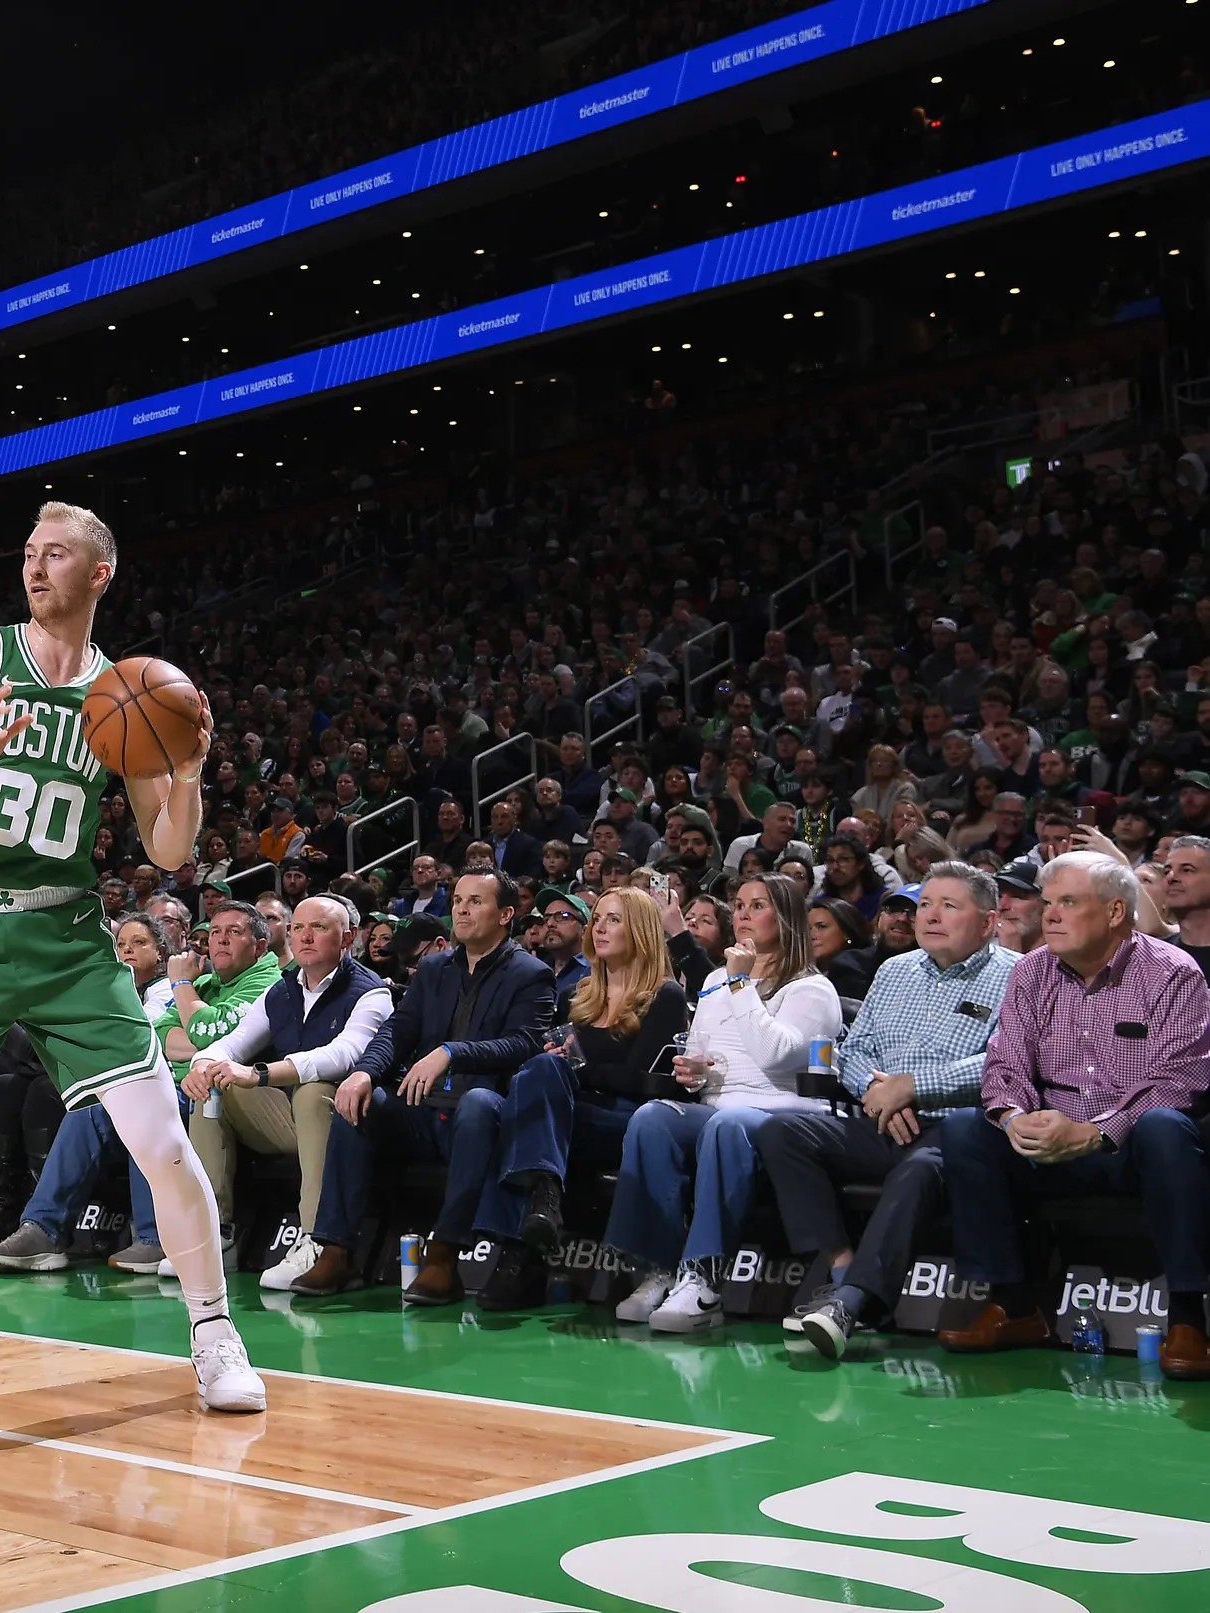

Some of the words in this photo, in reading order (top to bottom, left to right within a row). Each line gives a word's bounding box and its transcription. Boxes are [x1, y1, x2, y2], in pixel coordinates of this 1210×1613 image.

[711, 55, 732, 73] LIVE
[732, 47, 755, 66] ONLY
[755, 33, 798, 58] HAPPENS
[579, 86, 650, 119] ticketmaster
[1050, 158, 1074, 177] LIVE
[1075, 151, 1103, 170] ONLY
[1103, 136, 1154, 162] HAPPENS
[309, 194, 325, 210] LIVE
[324, 189, 342, 205] ONLY
[342, 178, 373, 198] HAPPENS
[891, 189, 976, 221] ticketmaster
[211, 218, 265, 244] ticketmaster
[6, 300, 19, 313] LIVE
[18, 295, 32, 309] ONLY
[31, 287, 56, 304] HAPPENS
[573, 290, 591, 306] LIVE
[591, 286, 611, 302] ONLY
[611, 275, 648, 296] HAPPENS
[458, 312, 521, 338] ticketmaster
[220, 388, 235, 402] LIVE
[234, 384, 250, 398] ONLY
[249, 376, 278, 394] HAPPENS
[132, 405, 181, 426] ticketmaster
[1056, 1272, 1168, 1317] jetBlu
